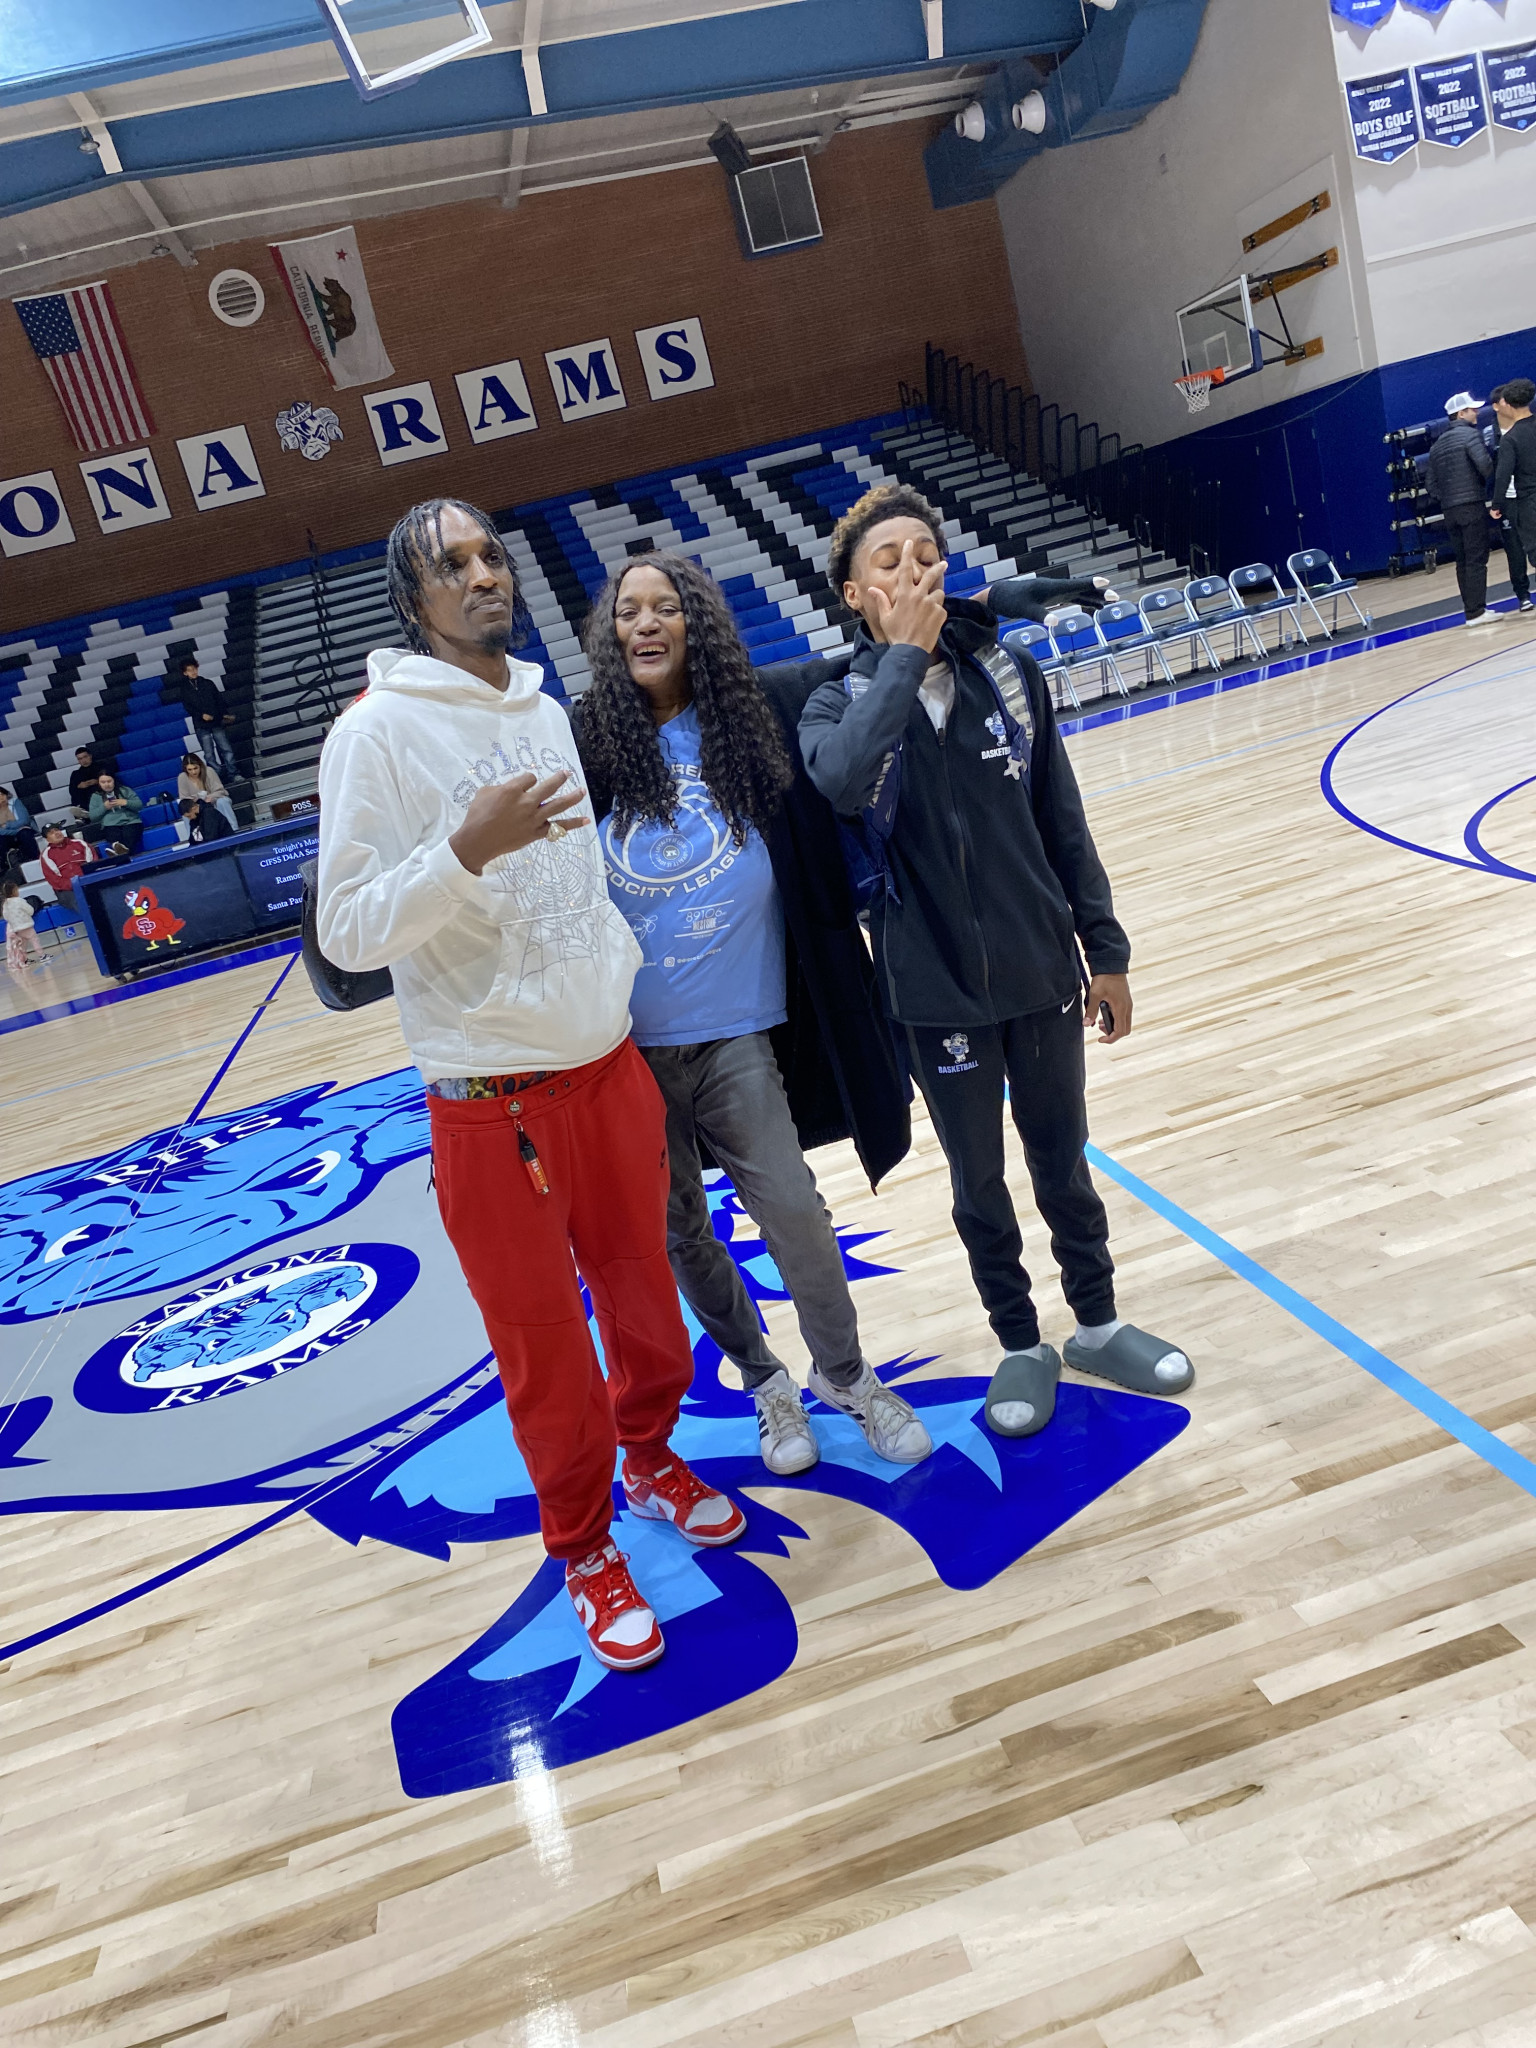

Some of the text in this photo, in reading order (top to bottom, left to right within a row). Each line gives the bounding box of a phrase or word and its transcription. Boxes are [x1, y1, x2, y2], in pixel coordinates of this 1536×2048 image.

[1503, 66, 1527, 80] 2022
[1438, 80, 1461, 95] 2022
[1492, 82, 1536, 103] FOOTBAL
[1368, 97, 1392, 112] 2022
[1425, 96, 1479, 119] SOFTBALL
[1354, 110, 1413, 136] BOYS GOLF
[290, 266, 314, 322] CALIFORNIA
[371, 329, 697, 452] RAMS
[292, 800, 312, 812] POSS
[273, 841, 304, 855] Tonight's
[259, 857, 282, 868] CIFSS
[282, 852, 305, 862] D4AA
[275, 872, 302, 885] Ramon
[267, 900, 288, 912] Santa
[937, 1059, 979, 1074] BASKETBALL
[84, 1114, 283, 1187] RHS
[114, 1245, 351, 1340] RAMONA
[196, 1297, 262, 1328] RHS
[149, 1318, 372, 1411] RAMS
